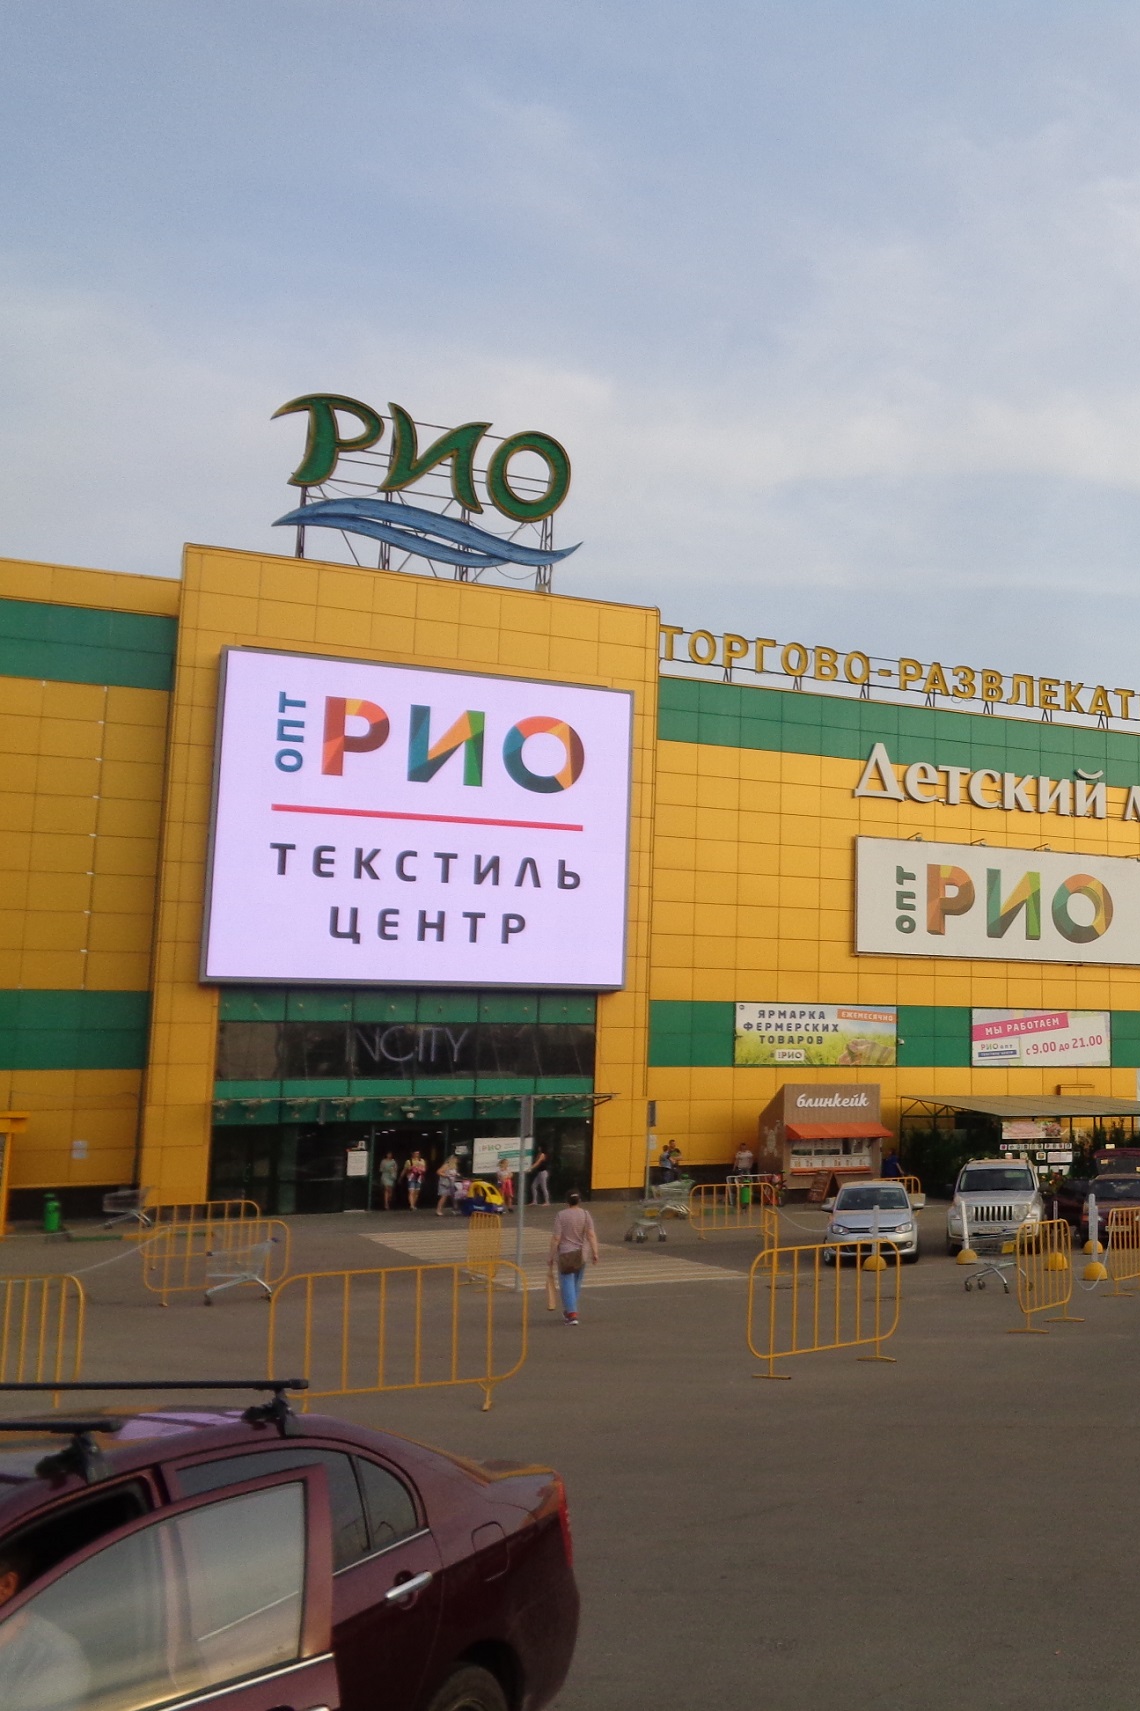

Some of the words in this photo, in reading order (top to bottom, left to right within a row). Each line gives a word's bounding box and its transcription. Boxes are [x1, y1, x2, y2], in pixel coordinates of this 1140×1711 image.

[270, 393, 571, 523] РИО
[275, 691, 306, 773] ОПТ
[321, 695, 585, 793] РИО
[854, 742, 1108, 820] Детский
[269, 842, 582, 889] ТЕКСТИЛЬ
[896, 865, 916, 934] ОПТ
[926, 863, 1114, 943] РИО
[329, 906, 527, 944] ЦЕНТР
[743, 1021, 839, 1033] ФЕРМЕРСКИХ
[757, 1009, 826, 1020] ЯРМАРКА
[841, 1011, 894, 1022] ЕЖЕМЕСЯЧНО
[985, 1025, 1002, 1036] МЫ
[1006, 1017, 1060, 1033] РАБОТАЕМ
[759, 1035, 824, 1045] ТОВАРОВ
[1031, 1041, 1056, 1055] 9.00
[1058, 1043, 1070, 1052] до
[1072, 1034, 1103, 1049] 21.00
[781, 1051, 802, 1060] РИО
[797, 1093, 869, 1107] блинкейк
